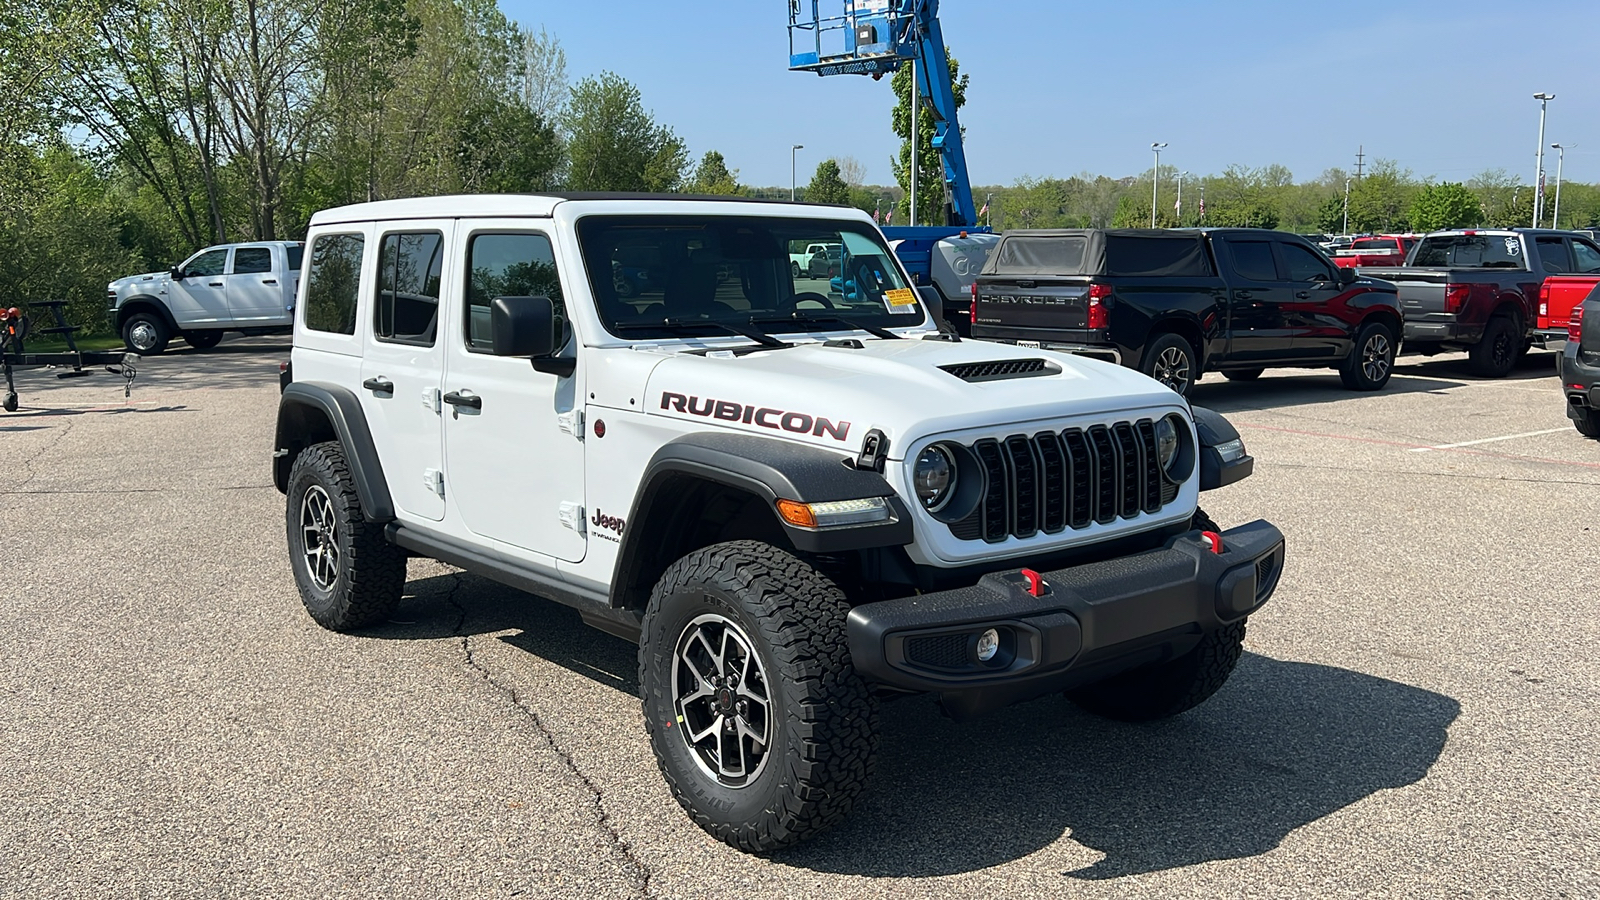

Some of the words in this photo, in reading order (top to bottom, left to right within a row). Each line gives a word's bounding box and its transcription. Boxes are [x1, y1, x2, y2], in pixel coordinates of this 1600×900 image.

[981, 294, 1078, 305] CHEVROLET
[660, 391, 851, 442] RUBICON
[591, 508, 626, 536] Jeep
